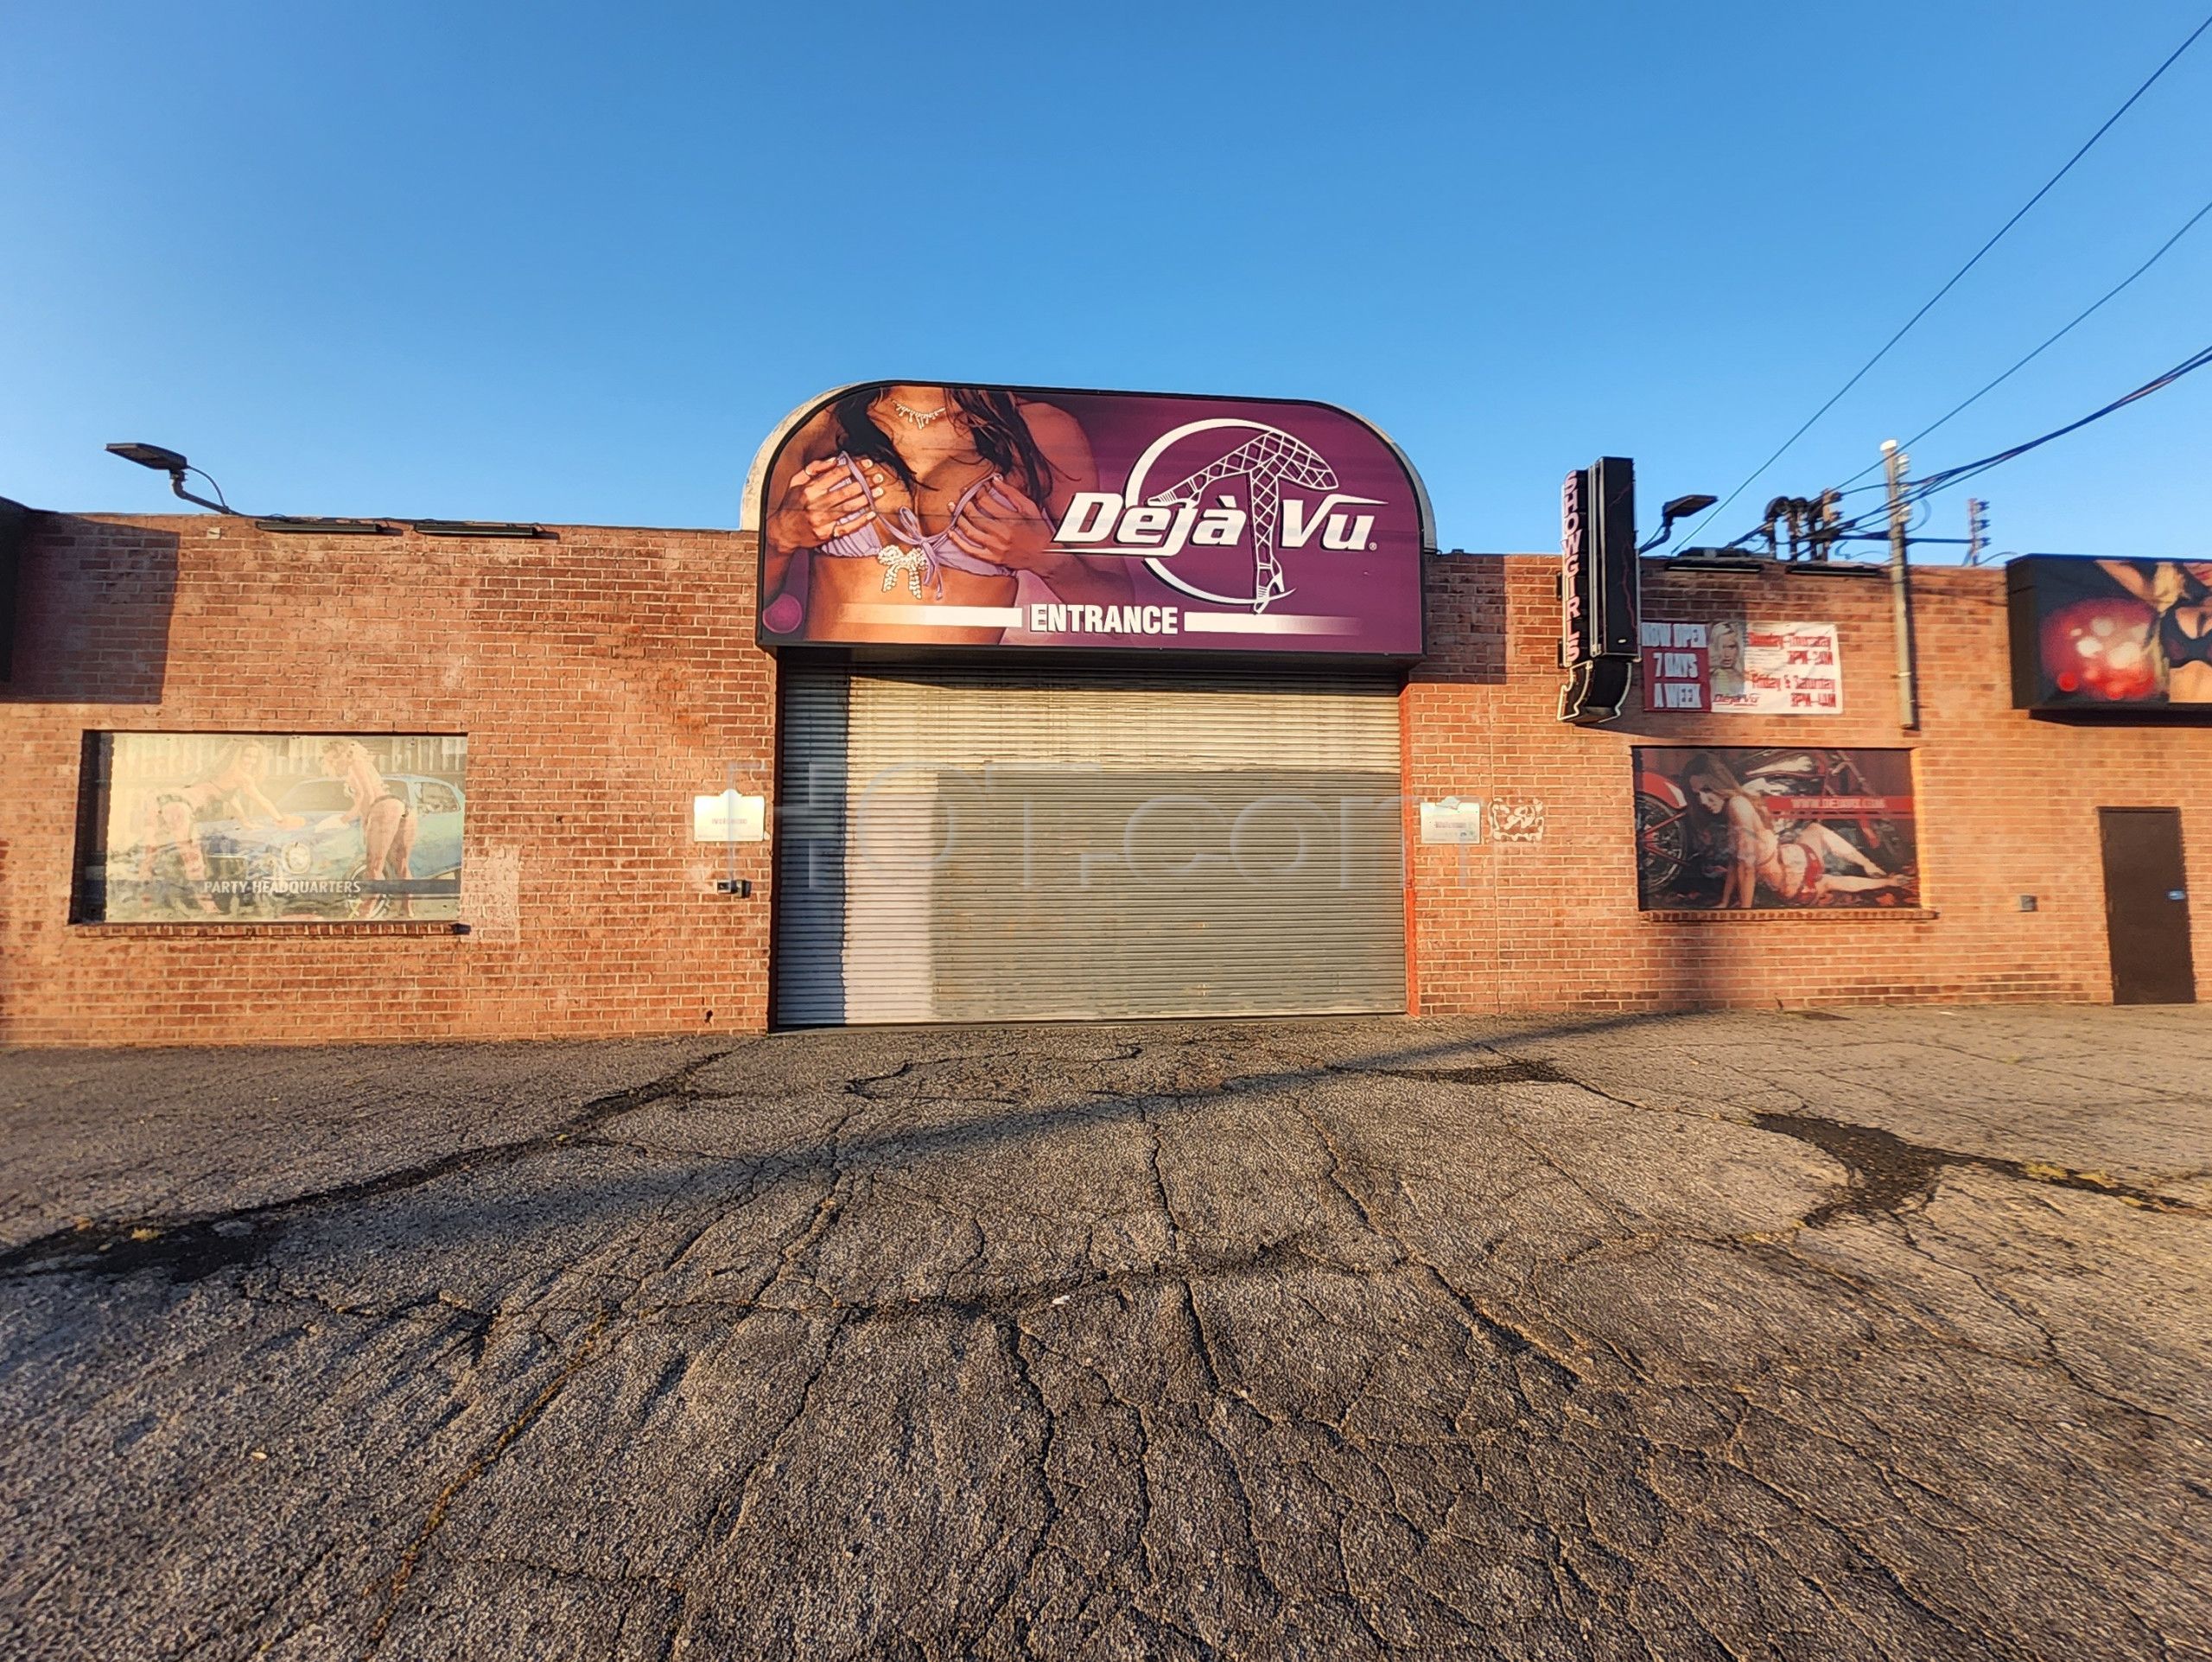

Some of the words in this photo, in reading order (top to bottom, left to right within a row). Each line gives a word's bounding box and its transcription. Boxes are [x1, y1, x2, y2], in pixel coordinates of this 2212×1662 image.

[1281, 494, 1389, 551] Vu
[1560, 469, 1583, 662] SHOWGIRLS
[1030, 604, 1179, 635] ENTRANCE
[1641, 622, 1672, 647] NOW
[1673, 623, 1707, 648] OPEN
[1653, 652, 1662, 678] 7
[1664, 653, 1699, 678] DAYS
[1654, 683, 1664, 708] A
[1664, 683, 1702, 708] WEEK
[203, 880, 248, 895] PARTY
[252, 880, 361, 896] HEADQUARTERS
